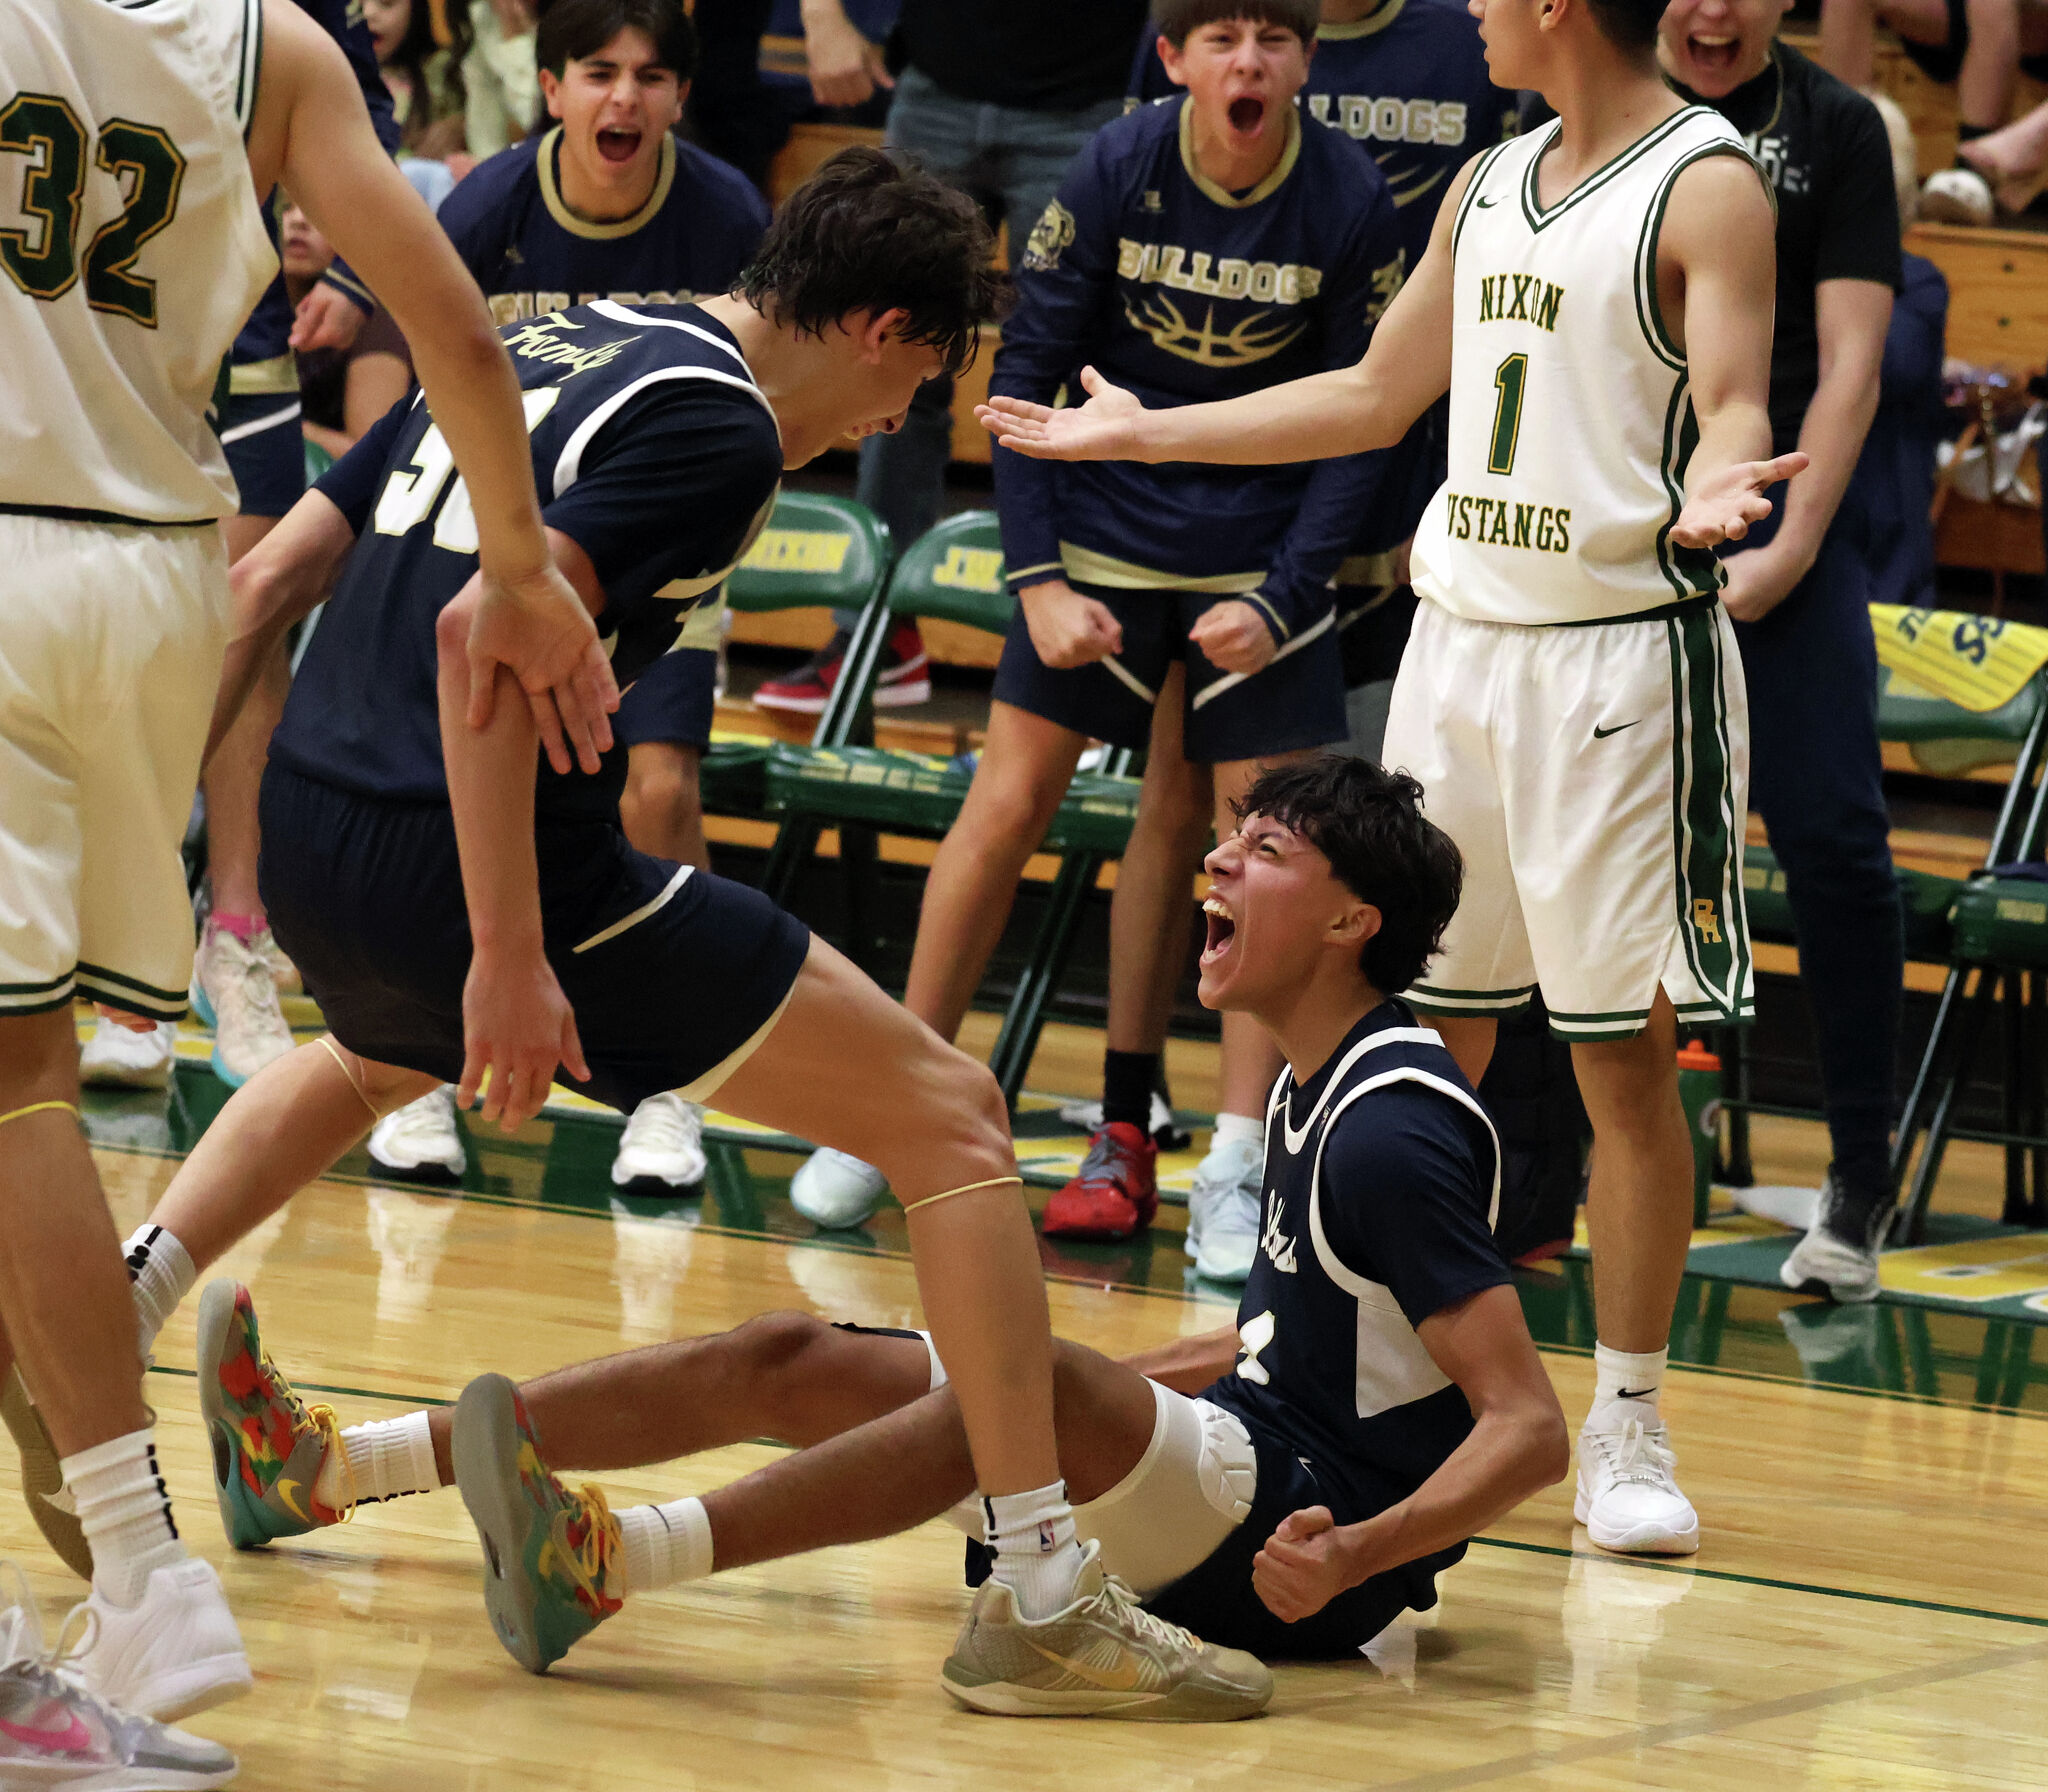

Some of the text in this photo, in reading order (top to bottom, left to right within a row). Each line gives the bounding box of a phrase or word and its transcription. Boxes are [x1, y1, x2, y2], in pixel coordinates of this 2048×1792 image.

[0, 91, 187, 330] 32
[1117, 237, 1323, 305] BULLDOGS
[1479, 272, 1565, 332] NIXON
[1487, 352, 1528, 476] 1
